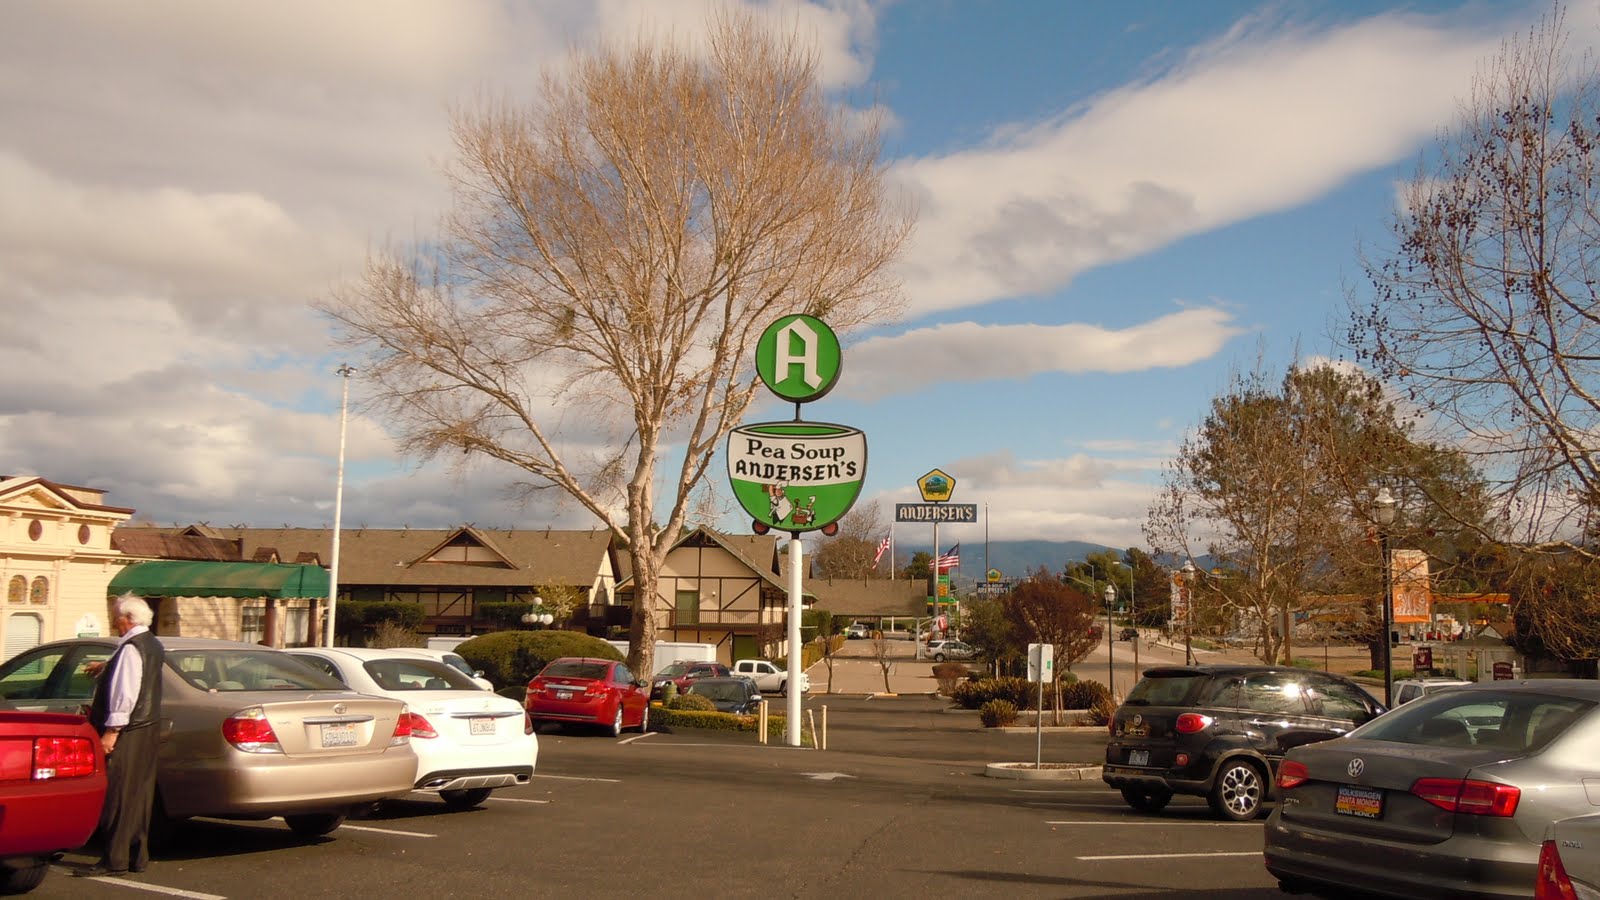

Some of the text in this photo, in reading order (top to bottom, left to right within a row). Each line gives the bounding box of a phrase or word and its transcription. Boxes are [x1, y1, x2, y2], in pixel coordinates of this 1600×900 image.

[775, 317, 823, 390] A
[746, 438, 846, 461] Pea Soup
[735, 459, 857, 481] ANDERSEN'S
[899, 505, 974, 520] ANDERSEN'S
[1337, 795, 1356, 806] SANTA
[1356, 798, 1380, 808] MONICA
[1338, 788, 1382, 800] VOLKSWAGEN
